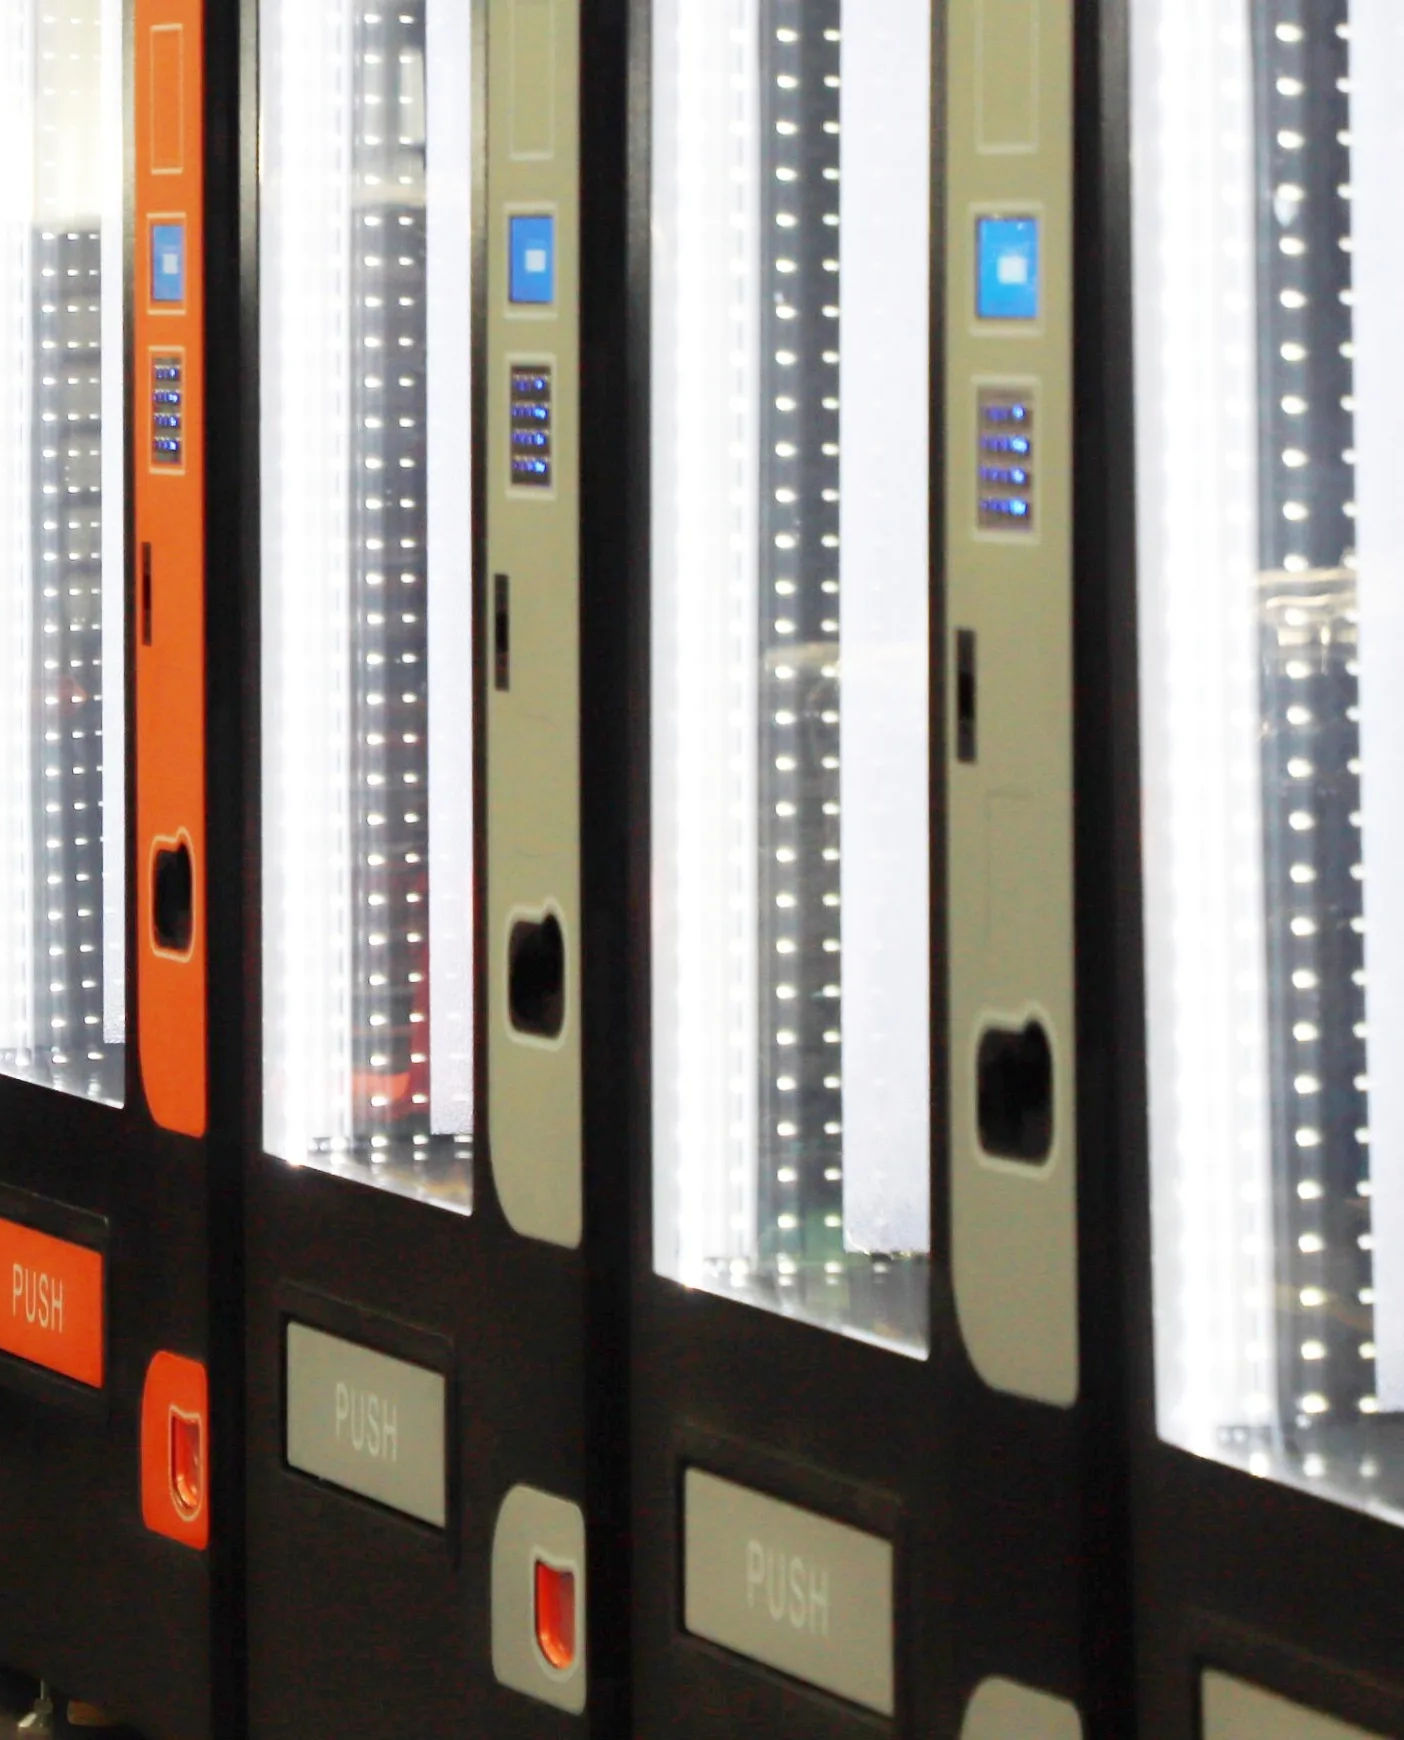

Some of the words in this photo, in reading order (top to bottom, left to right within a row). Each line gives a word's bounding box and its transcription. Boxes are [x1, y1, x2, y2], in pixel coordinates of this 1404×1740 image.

[12, 1264, 63, 1333] PUSH
[334, 1382, 397, 1462] PUSH
[747, 1541, 829, 1635] PUSH
